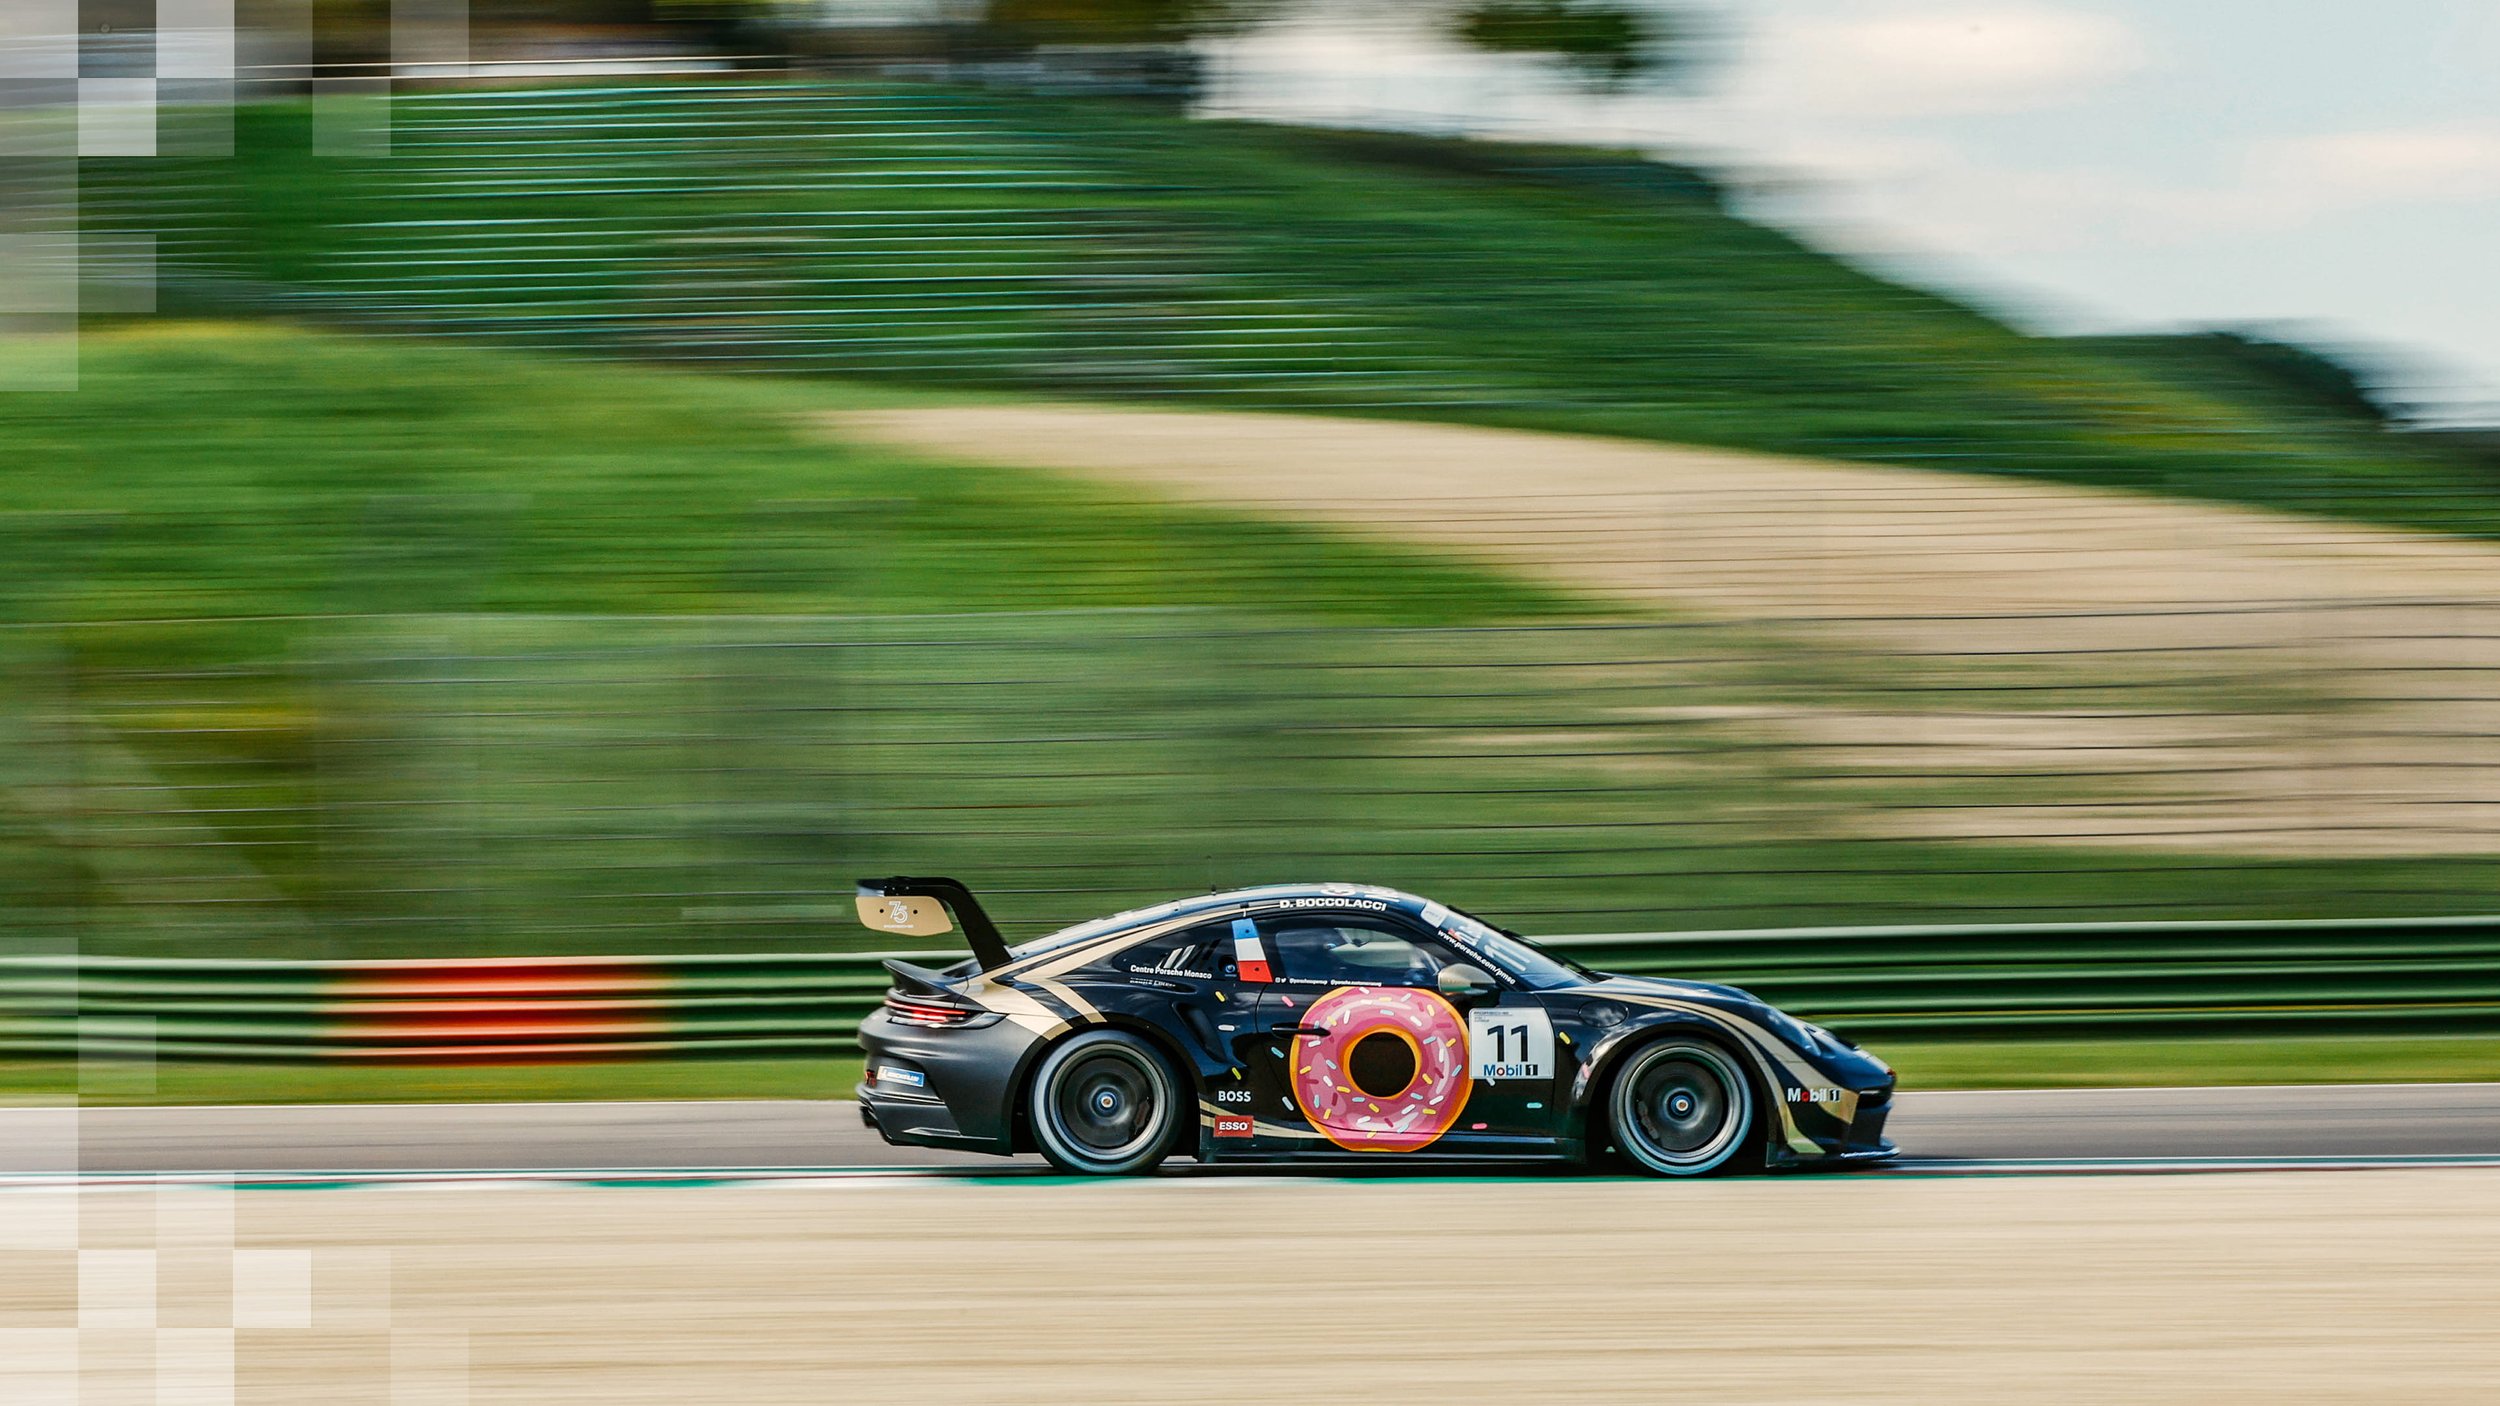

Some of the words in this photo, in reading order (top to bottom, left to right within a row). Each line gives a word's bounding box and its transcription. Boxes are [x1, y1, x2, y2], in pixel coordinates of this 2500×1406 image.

[1280, 900, 1294, 908] D.
[1296, 898, 1387, 911] BOCCOLACCI
[889, 901, 908, 923] 75
[1130, 964, 1154, 974] Centre
[1155, 967, 1183, 977] Porsche
[1184, 970, 1213, 979] Monaco
[1487, 1024, 1528, 1062] 11
[1484, 1064, 1522, 1076] Mobil
[1218, 1091, 1251, 1102] BOSS
[1787, 1087, 1827, 1102] Mobil
[1829, 1089, 1840, 1102] 1
[1219, 1122, 1248, 1131] ESSO
